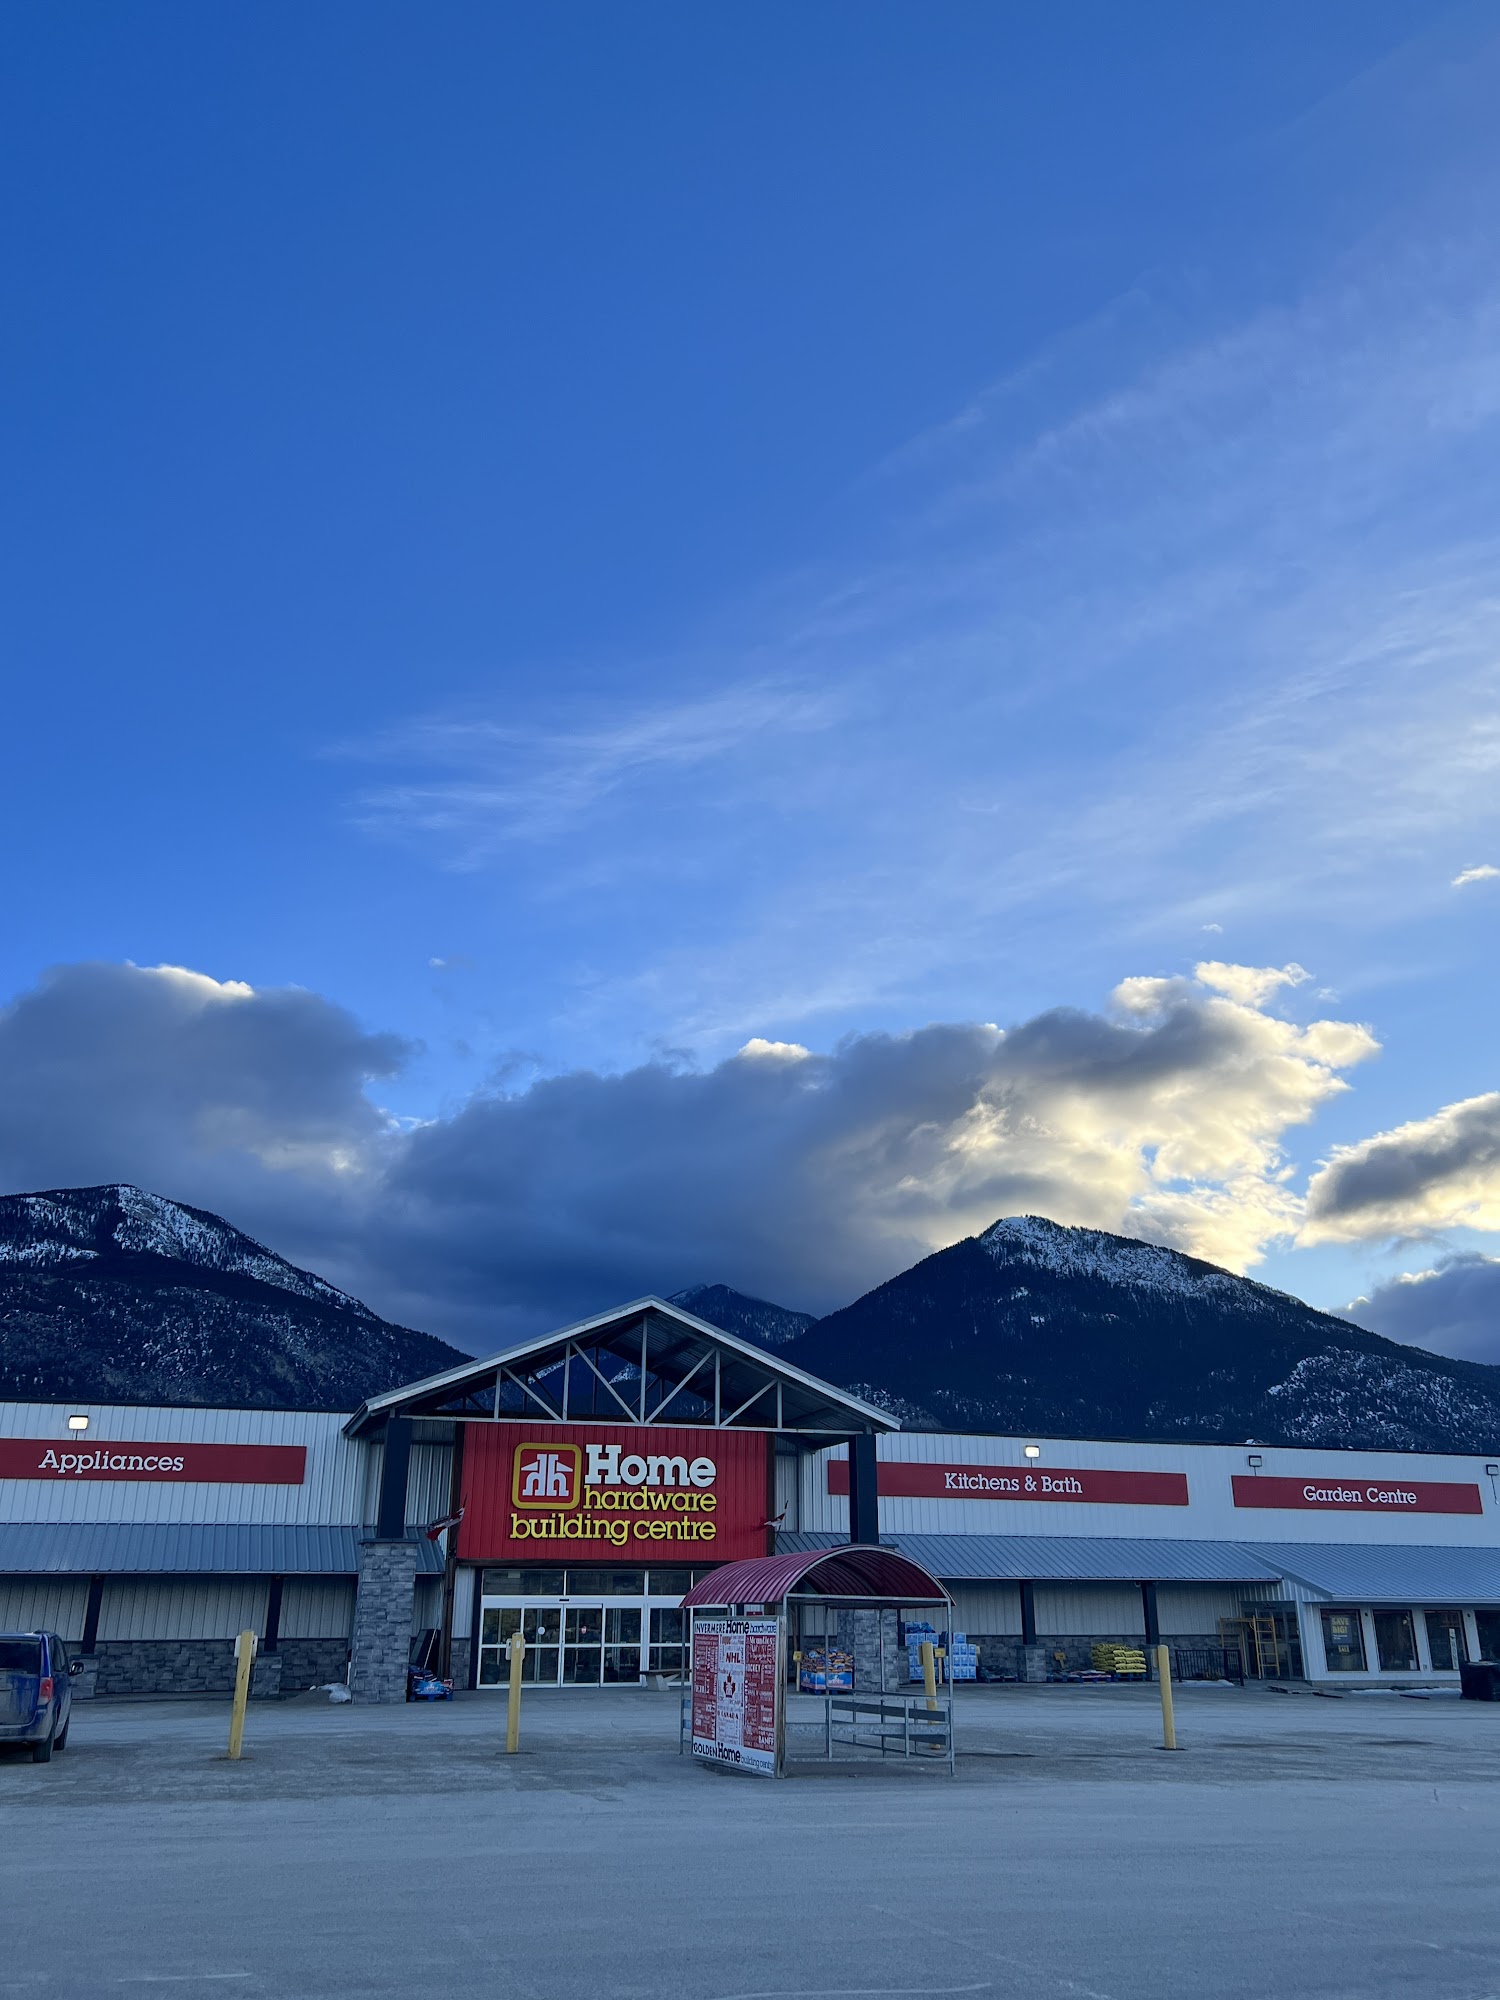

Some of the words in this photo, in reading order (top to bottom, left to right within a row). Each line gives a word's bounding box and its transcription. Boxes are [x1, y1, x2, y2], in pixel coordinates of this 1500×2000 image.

[38, 1449, 185, 1474] Appliances
[585, 1444, 717, 1487] Home
[944, 1472, 1020, 1491] Kitchens
[1024, 1475, 1037, 1492] &
[1040, 1475, 1083, 1494] Bath
[1303, 1485, 1363, 1503] Garden
[1366, 1487, 1417, 1504] Centre
[583, 1485, 717, 1512] hardware
[510, 1513, 630, 1546] building
[633, 1516, 717, 1540] centre
[695, 1622, 726, 1634] INVERMERE
[726, 1619, 750, 1634] Home
[1331, 1617, 1349, 1626] SAVE
[725, 1652, 741, 1663] NHL
[693, 1742, 717, 1757] GOLDEN
[717, 1741, 741, 1763] Home
[740, 1754, 760, 1769] building
